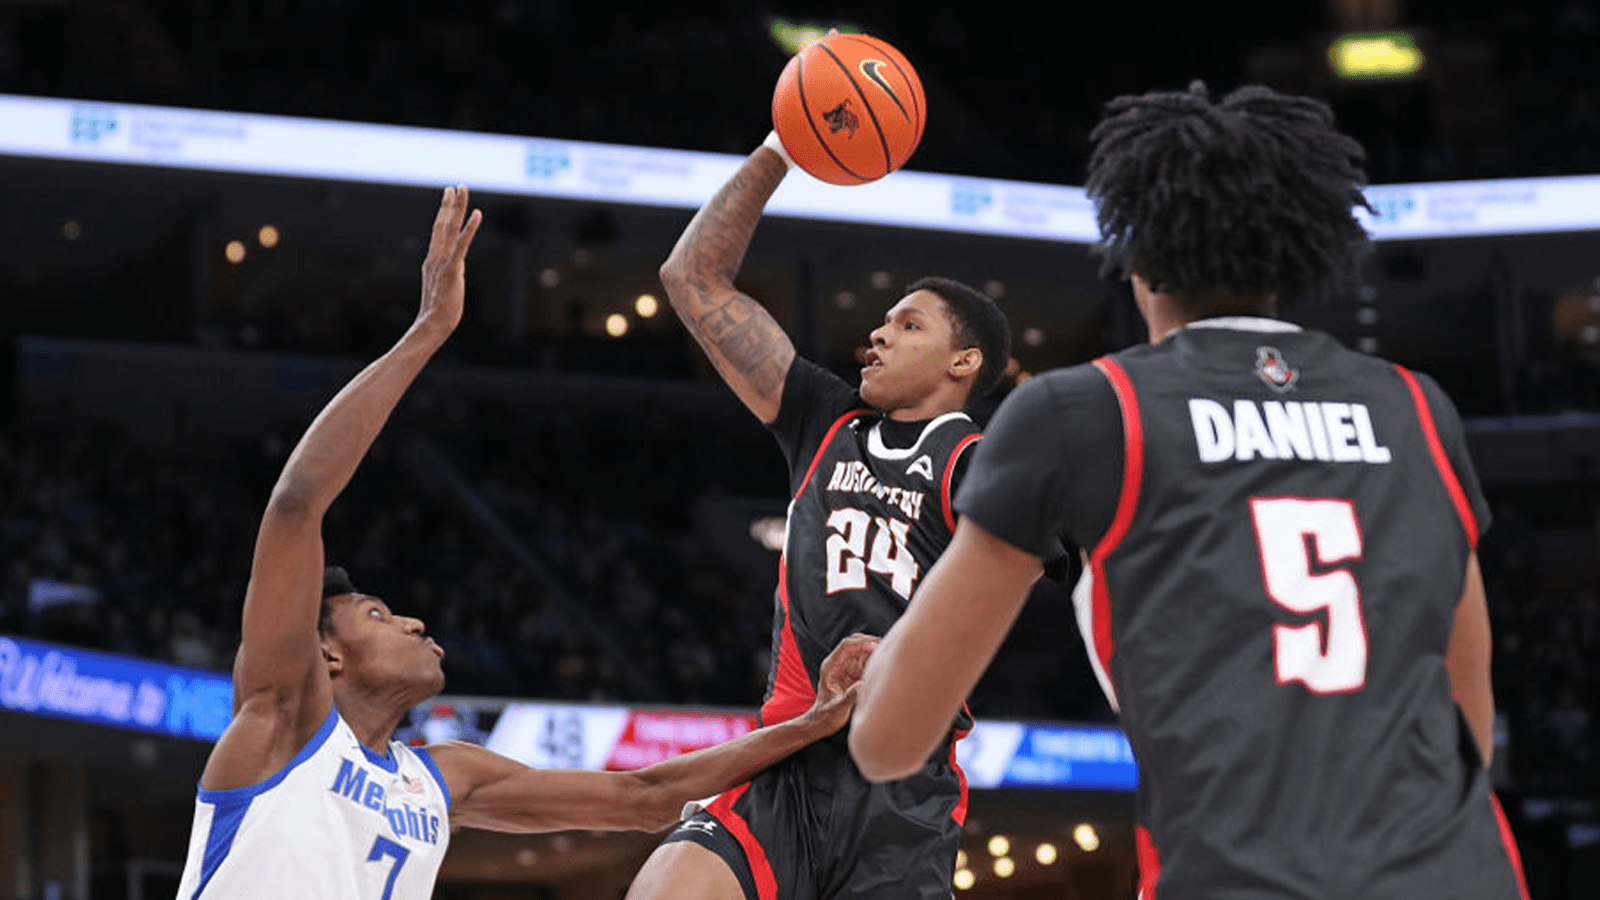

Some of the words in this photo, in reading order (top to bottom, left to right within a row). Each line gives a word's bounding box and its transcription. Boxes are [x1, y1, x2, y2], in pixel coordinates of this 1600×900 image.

[1188, 398, 1392, 464] DANIEL
[825, 506, 920, 601] 24
[1248, 495, 1369, 696] 5
[329, 756, 439, 846] Mephis
[365, 834, 411, 900] 7
